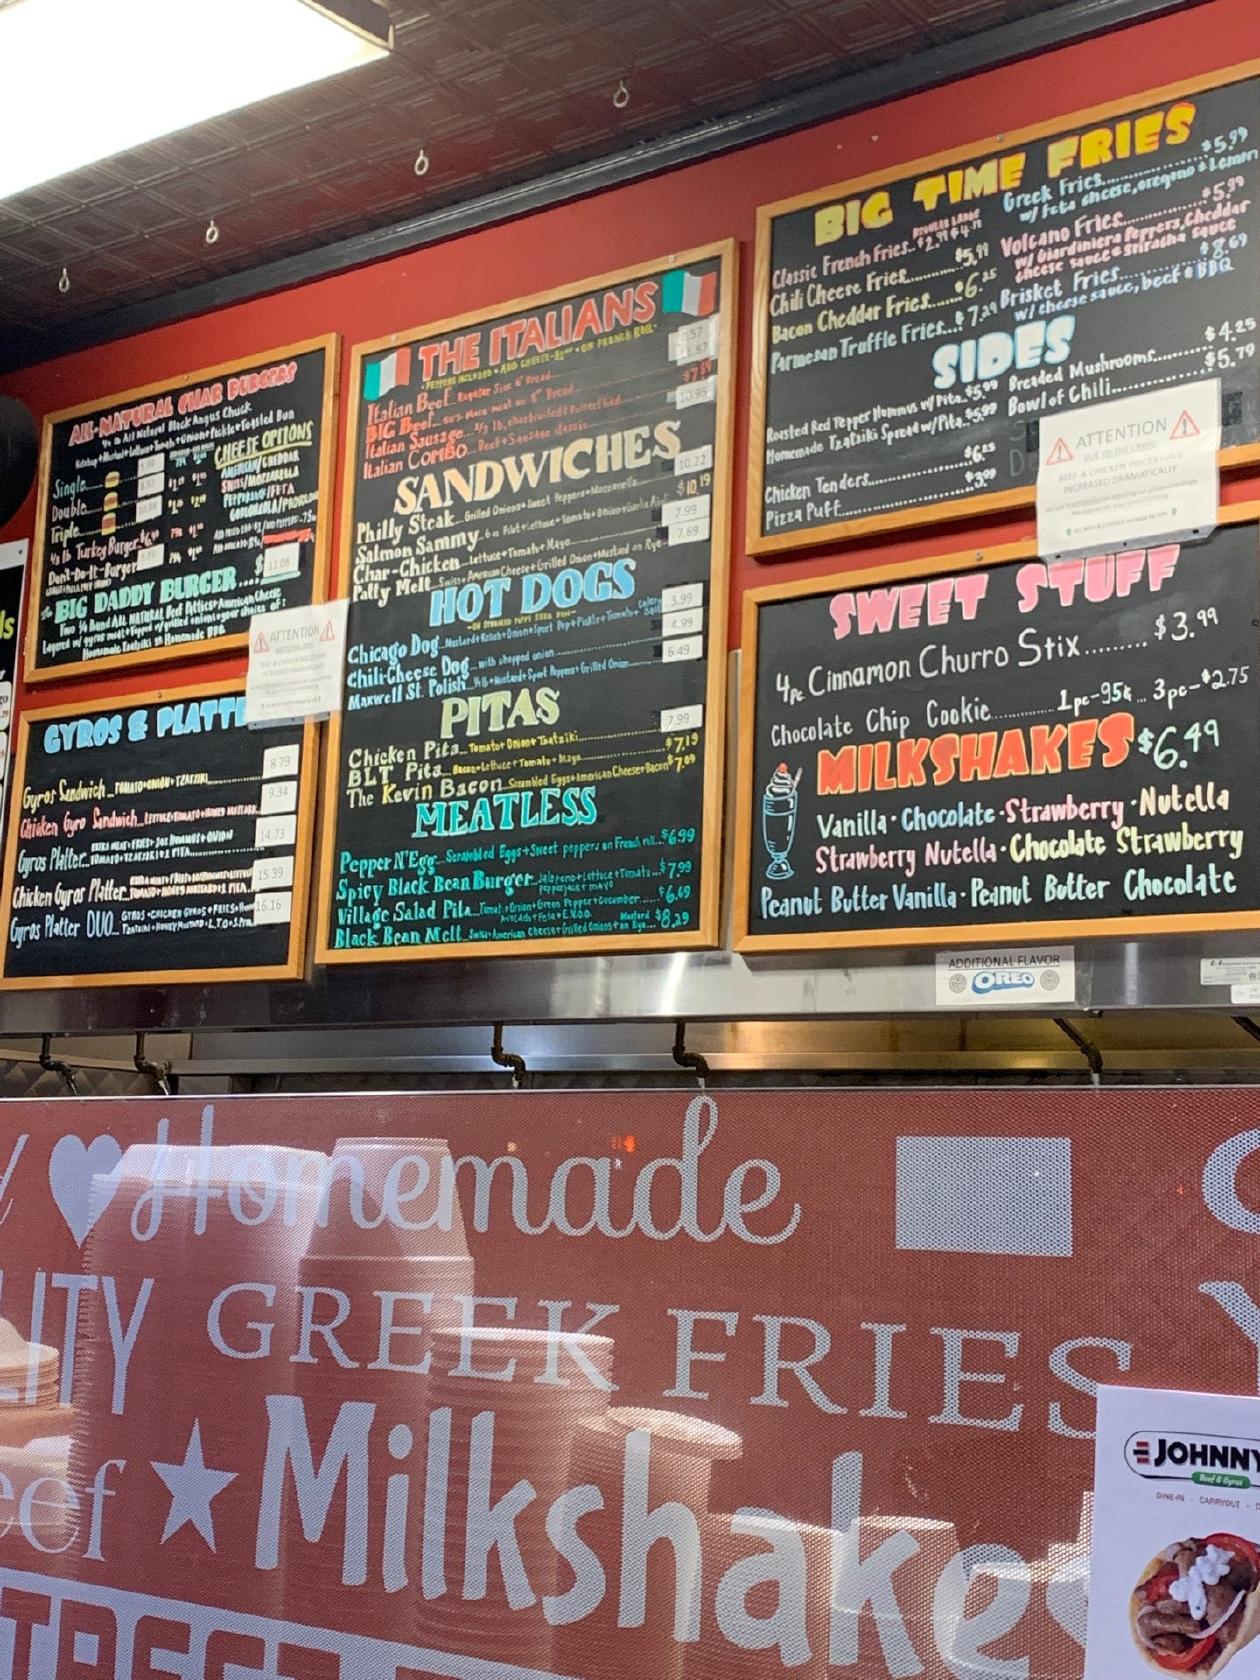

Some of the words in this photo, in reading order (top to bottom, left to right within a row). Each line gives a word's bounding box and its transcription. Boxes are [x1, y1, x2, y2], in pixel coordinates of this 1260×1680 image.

[814, 191, 894, 248] BIG
[912, 152, 1026, 212] TIME
[1047, 100, 1197, 178] FRIES
[1002, 184, 1052, 213] Greek
[1059, 173, 1102, 197] Fries
[1000, 226, 1071, 259] Volcano
[1074, 210, 1124, 238] Fries
[771, 265, 817, 290] Classic
[822, 249, 871, 276] French
[873, 242, 908, 262] Fries
[1000, 278, 1064, 309] Brisket
[1073, 266, 1121, 292] Fries
[1194, 257, 1234, 281] BBQ
[769, 290, 804, 318] Chili
[806, 282, 862, 307] Cheese
[866, 268, 908, 292] Fries
[418, 332, 482, 382] THE
[489, 281, 659, 367] ITALIANS
[771, 324, 813, 345] Bacon
[816, 305, 882, 333] Cheddar
[885, 292, 930, 319] Fries
[770, 346, 838, 375] Parmesan
[839, 330, 898, 359] Truffle
[901, 321, 945, 345] Fries
[931, 314, 1076, 390] SIDES
[1008, 371, 1064, 392] Breaded
[1069, 349, 1156, 379] Mushrooms
[1204, 317, 1257, 342] $4.25
[227, 361, 298, 401] BURGERS
[1008, 394, 1047, 417] Bowl
[1049, 390, 1065, 408] of
[1068, 378, 1111, 404] Chili
[1204, 343, 1256, 369] $5.79
[366, 419, 396, 444] BIG
[400, 410, 434, 437] Beef
[367, 400, 413, 426] Italian
[416, 386, 452, 413] Beef
[213, 436, 259, 466] CHEESE
[261, 420, 314, 448] OPTIONS
[365, 438, 405, 460] Italian
[409, 427, 464, 451] Sausage
[1075, 416, 1168, 449] ATTENTION
[53, 475, 86, 499] Single
[363, 458, 404, 480] Italian
[394, 419, 681, 516] SANDWICHES
[764, 484, 812, 505] Chicken
[815, 472, 870, 494] Tenders
[52, 499, 87, 522] Double
[356, 517, 403, 545] Philly
[408, 509, 456, 535] Steak
[765, 509, 804, 531] Pizza
[806, 499, 842, 521] Puff
[50, 521, 79, 547] Triple
[107, 536, 138, 558] Burger
[355, 544, 413, 565] Salmon
[416, 529, 480, 555] Sammy
[353, 555, 461, 585] Char-Chicken
[54, 595, 88, 624] BIG
[94, 580, 156, 614] DADDY
[159, 566, 237, 604] BURGER
[352, 583, 391, 608] Patty
[396, 576, 431, 597] Melt
[429, 576, 512, 627] HOT
[519, 557, 636, 615] DOGS
[829, 573, 989, 640] SWEET
[1016, 544, 1181, 613] STUFF
[347, 641, 408, 665] Chicago
[410, 633, 440, 658] Dog
[808, 658, 912, 697] Cinnamon
[919, 644, 1009, 679] Churro
[1018, 628, 1081, 667] Stix
[1153, 607, 1219, 641] $3.99
[347, 663, 437, 689] Chili-Cheese
[441, 655, 470, 679] Dog
[347, 684, 403, 711] Maxwell
[428, 677, 467, 698] Polish
[440, 687, 560, 739] PITAS
[43, 714, 122, 754] GYROS
[128, 708, 149, 742] &
[157, 695, 247, 738] PLATTE
[770, 714, 853, 747] Chocolate
[866, 706, 910, 739] Chip
[926, 695, 992, 728] Cookie
[348, 745, 417, 768] Chicken
[423, 740, 460, 760] Pita
[348, 765, 394, 788] BLT
[405, 761, 442, 781] Pita
[665, 732, 698, 754] $7.19
[817, 712, 1135, 796] MILKSHAKES
[1137, 718, 1220, 770] $6.49
[23, 786, 56, 814] Gyros
[58, 778, 105, 802] Sandwich
[346, 788, 374, 809] The
[381, 782, 433, 805] Kevin
[439, 778, 502, 799] Bacon
[411, 785, 597, 838] MEATLESS
[816, 809, 887, 839] Vanilla
[901, 801, 996, 832] Chocolate
[1005, 794, 1124, 830] Strawberry
[1139, 781, 1230, 817] Nutella
[20, 816, 59, 839] Chicken
[63, 810, 87, 838] Gyro
[92, 806, 138, 830] Sandwich
[17, 848, 47, 879] Gyros
[50, 845, 87, 871] Platter
[340, 850, 393, 879] Pepper
[661, 827, 696, 845] $6.99
[815, 844, 916, 878] Strawberry
[925, 836, 997, 867] Nutella
[1009, 828, 1106, 864] Chocolate
[1116, 821, 1244, 860] Strawberry
[12, 885, 52, 909] Chicken
[54, 881, 86, 911] Gyros
[88, 877, 129, 902] Platter
[335, 878, 384, 907] Spicy
[388, 875, 429, 897] Black
[433, 874, 472, 893] Bean
[472, 870, 534, 897] Burger
[659, 858, 693, 879] $7.99
[760, 886, 823, 920] Peanut
[831, 884, 889, 914] Butter
[892, 882, 957, 911] Vanilla
[971, 875, 1032, 907] Peanut
[1044, 872, 1111, 902] Butter
[1124, 862, 1237, 901] Chocolate
[10, 915, 41, 949] Gyros
[44, 914, 80, 938] Platter
[87, 909, 114, 938] DUO
[334, 927, 380, 949] Black
[383, 926, 422, 945] Bean
[424, 925, 463, 944] Melt
[655, 908, 690, 929] $8.29
[338, 905, 390, 931] Village
[393, 900, 436, 922] Salad
[443, 899, 473, 919] Pita
[658, 885, 691, 904] $6.69
[948, 957, 1016, 969] ADDITIONAL
[1018, 953, 1060, 967] FLAVOR
[972, 970, 1035, 994] OREO
[131, 1096, 801, 1246] Homemade
[0, 1270, 154, 1415] ITY
[206, 1281, 619, 1392] GREEK
[664, 1309, 1133, 1441] FRIES
[0, 1459, 127, 1562] ef
[1156, 1491, 1185, 1502] DINE-IN
[1199, 1496, 1240, 1509] CARRYOUT
